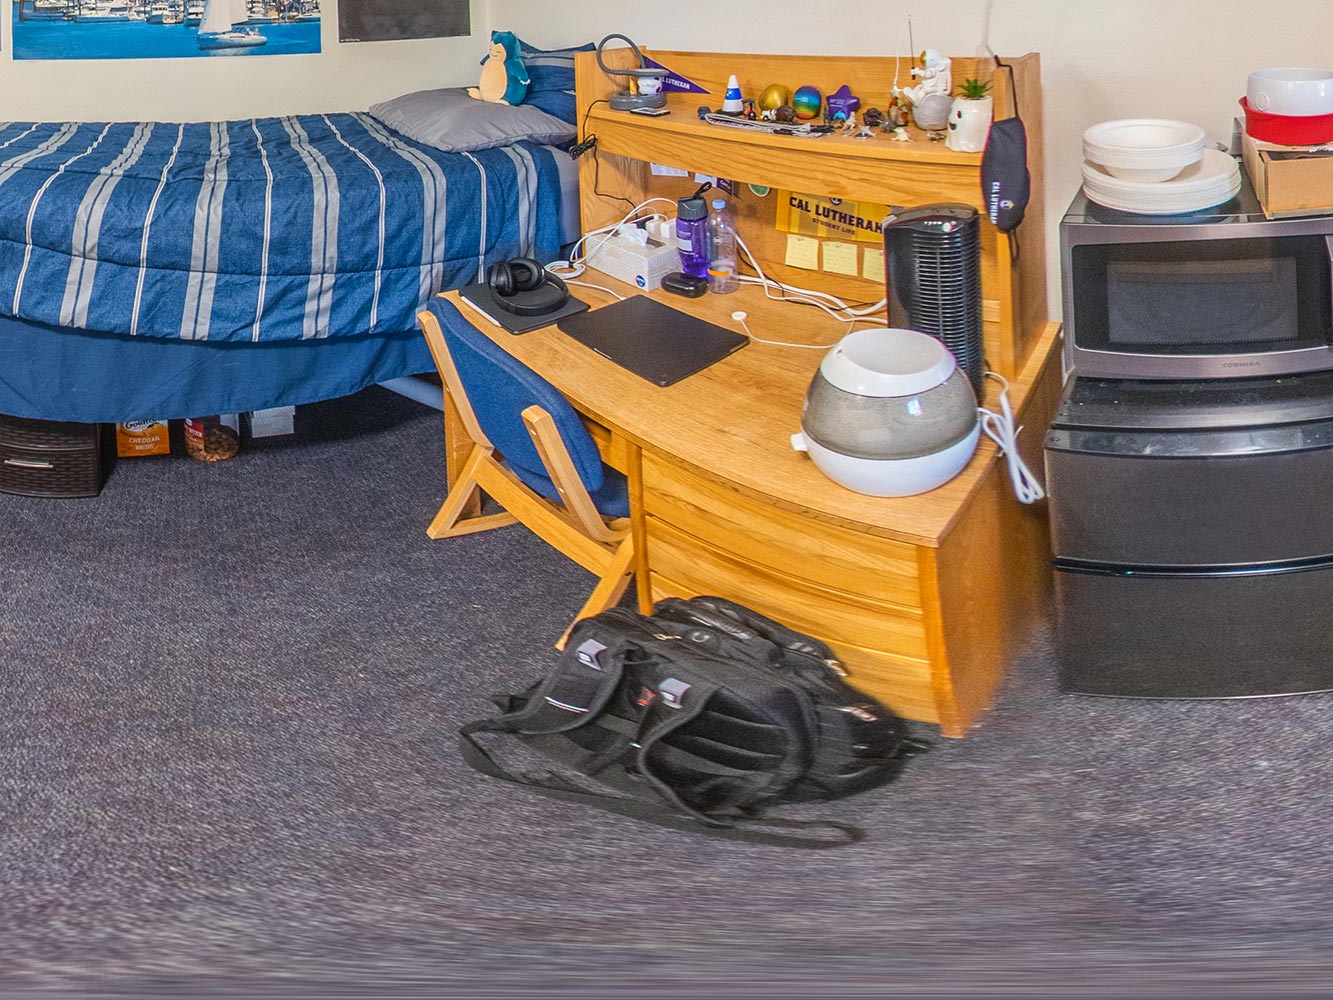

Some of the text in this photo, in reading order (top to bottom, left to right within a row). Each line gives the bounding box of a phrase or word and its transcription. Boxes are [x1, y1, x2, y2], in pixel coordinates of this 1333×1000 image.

[992, 182, 1000, 193] CAL
[789, 196, 883, 235] CAL LUTHERAN
[129, 435, 160, 444] CHEDDAR
